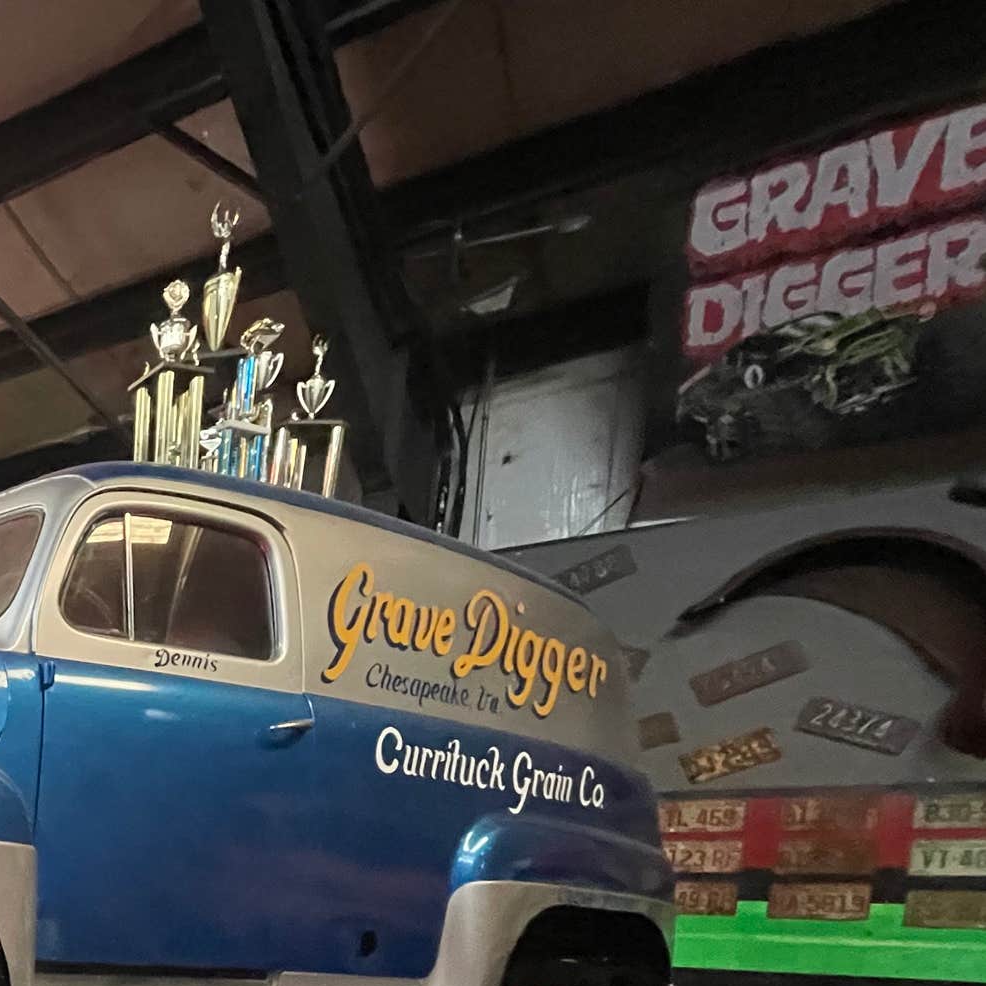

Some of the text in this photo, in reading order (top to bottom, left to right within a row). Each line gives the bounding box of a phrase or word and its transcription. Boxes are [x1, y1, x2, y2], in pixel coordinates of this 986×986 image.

[690, 102, 986, 256] GRAVE
[685, 219, 986, 347] DIGGER
[154, 648, 219, 673] Dennis
[321, 561, 608, 719] Grave Digger
[375, 726, 506, 791] Currituck
[508, 751, 574, 815] Grain
